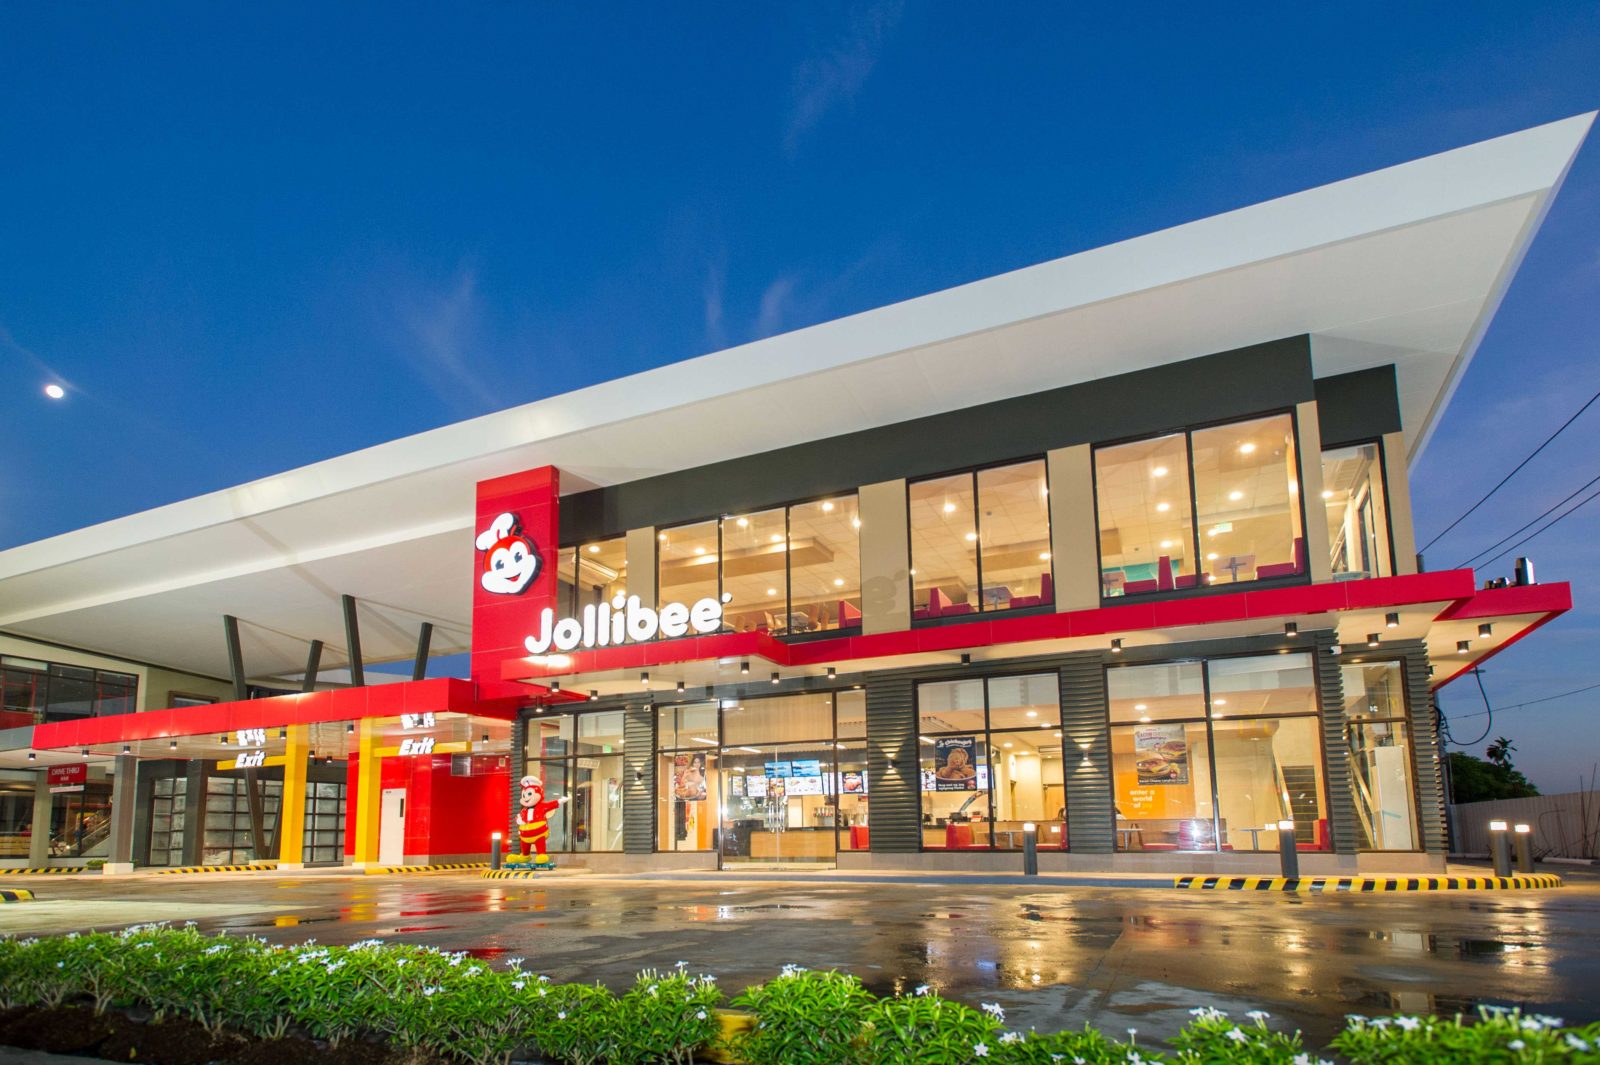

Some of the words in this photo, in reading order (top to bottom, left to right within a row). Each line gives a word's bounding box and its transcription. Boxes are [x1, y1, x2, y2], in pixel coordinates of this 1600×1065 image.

[524, 594, 722, 654] Jollibee
[398, 737, 436, 756] Exit
[235, 750, 266, 768] Exit
